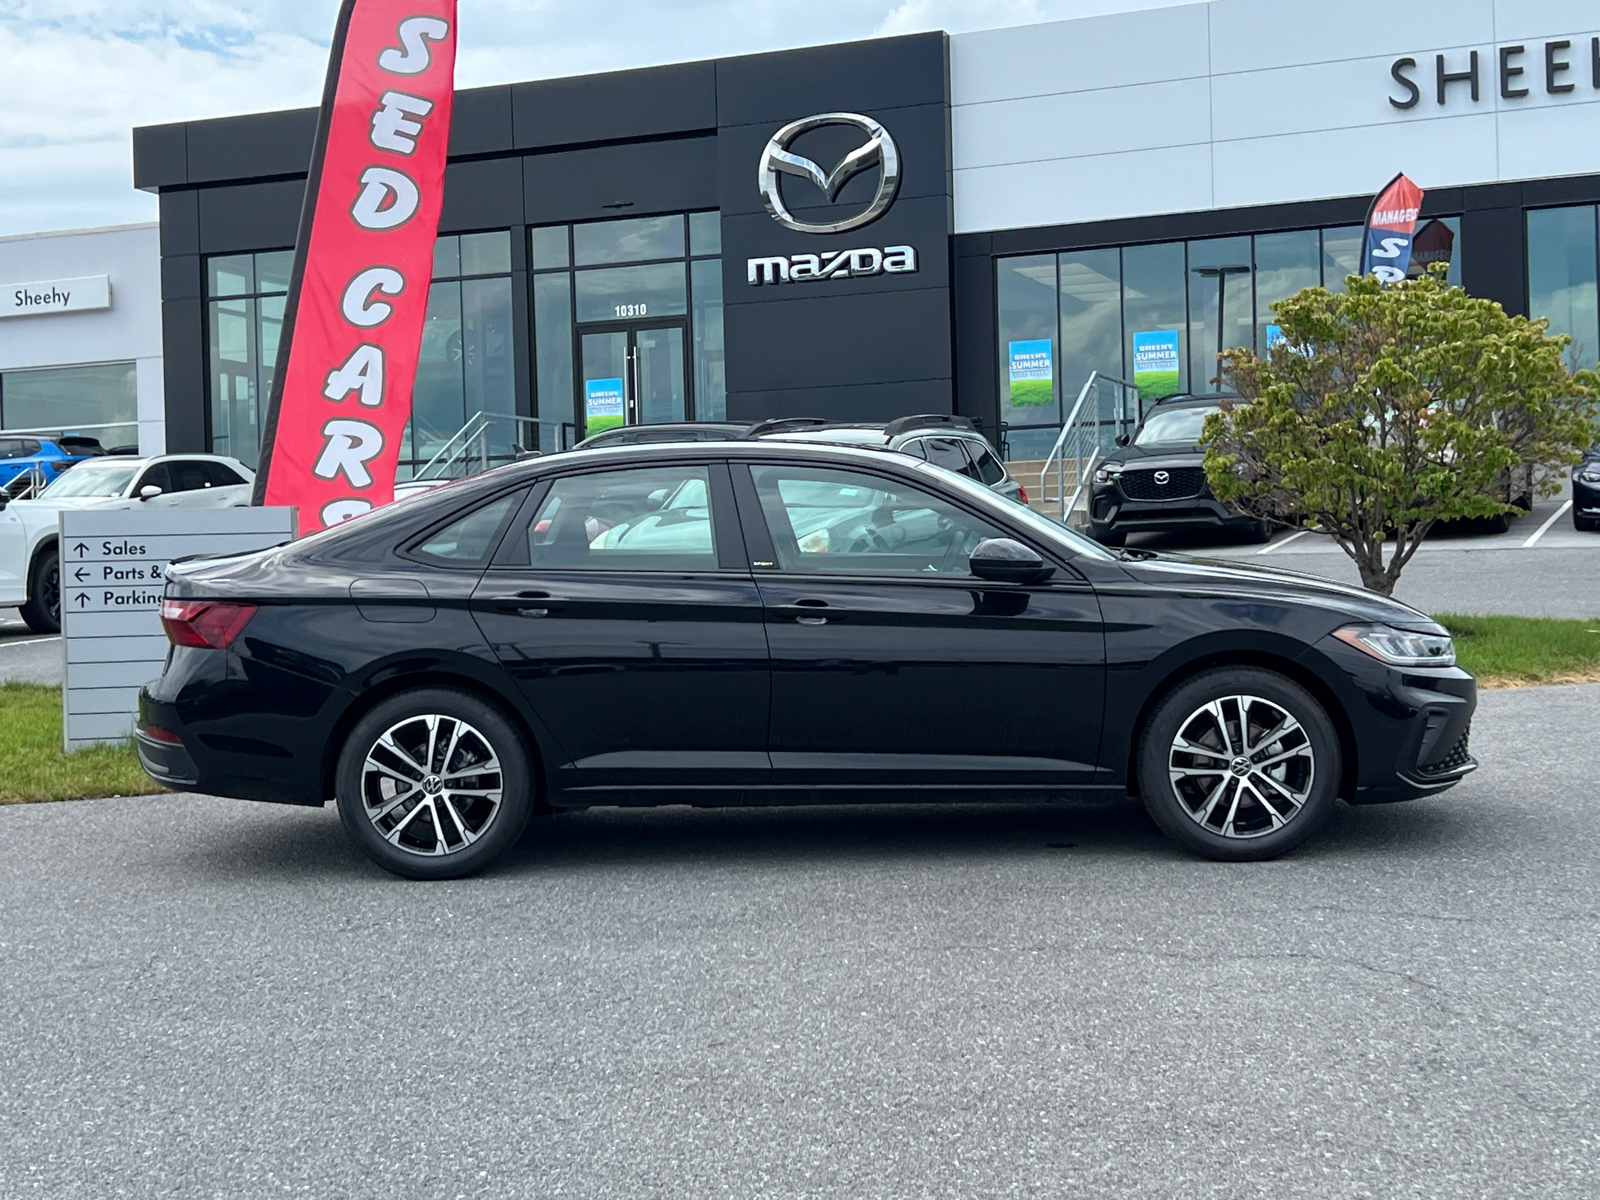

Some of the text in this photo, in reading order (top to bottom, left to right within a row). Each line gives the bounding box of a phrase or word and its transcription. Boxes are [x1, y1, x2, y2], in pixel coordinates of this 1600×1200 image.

[1389, 37, 1600, 109] SHEE
[351, 14, 449, 231] SED
[15, 286, 71, 307] Sheehy
[614, 303, 647, 317] 10310
[1135, 350, 1177, 361] SUMMER
[1011, 359, 1050, 370] SUMMER
[588, 397, 622, 406] SUMMER
[102, 540, 146, 556] Sales
[103, 565, 162, 580] Parts &
